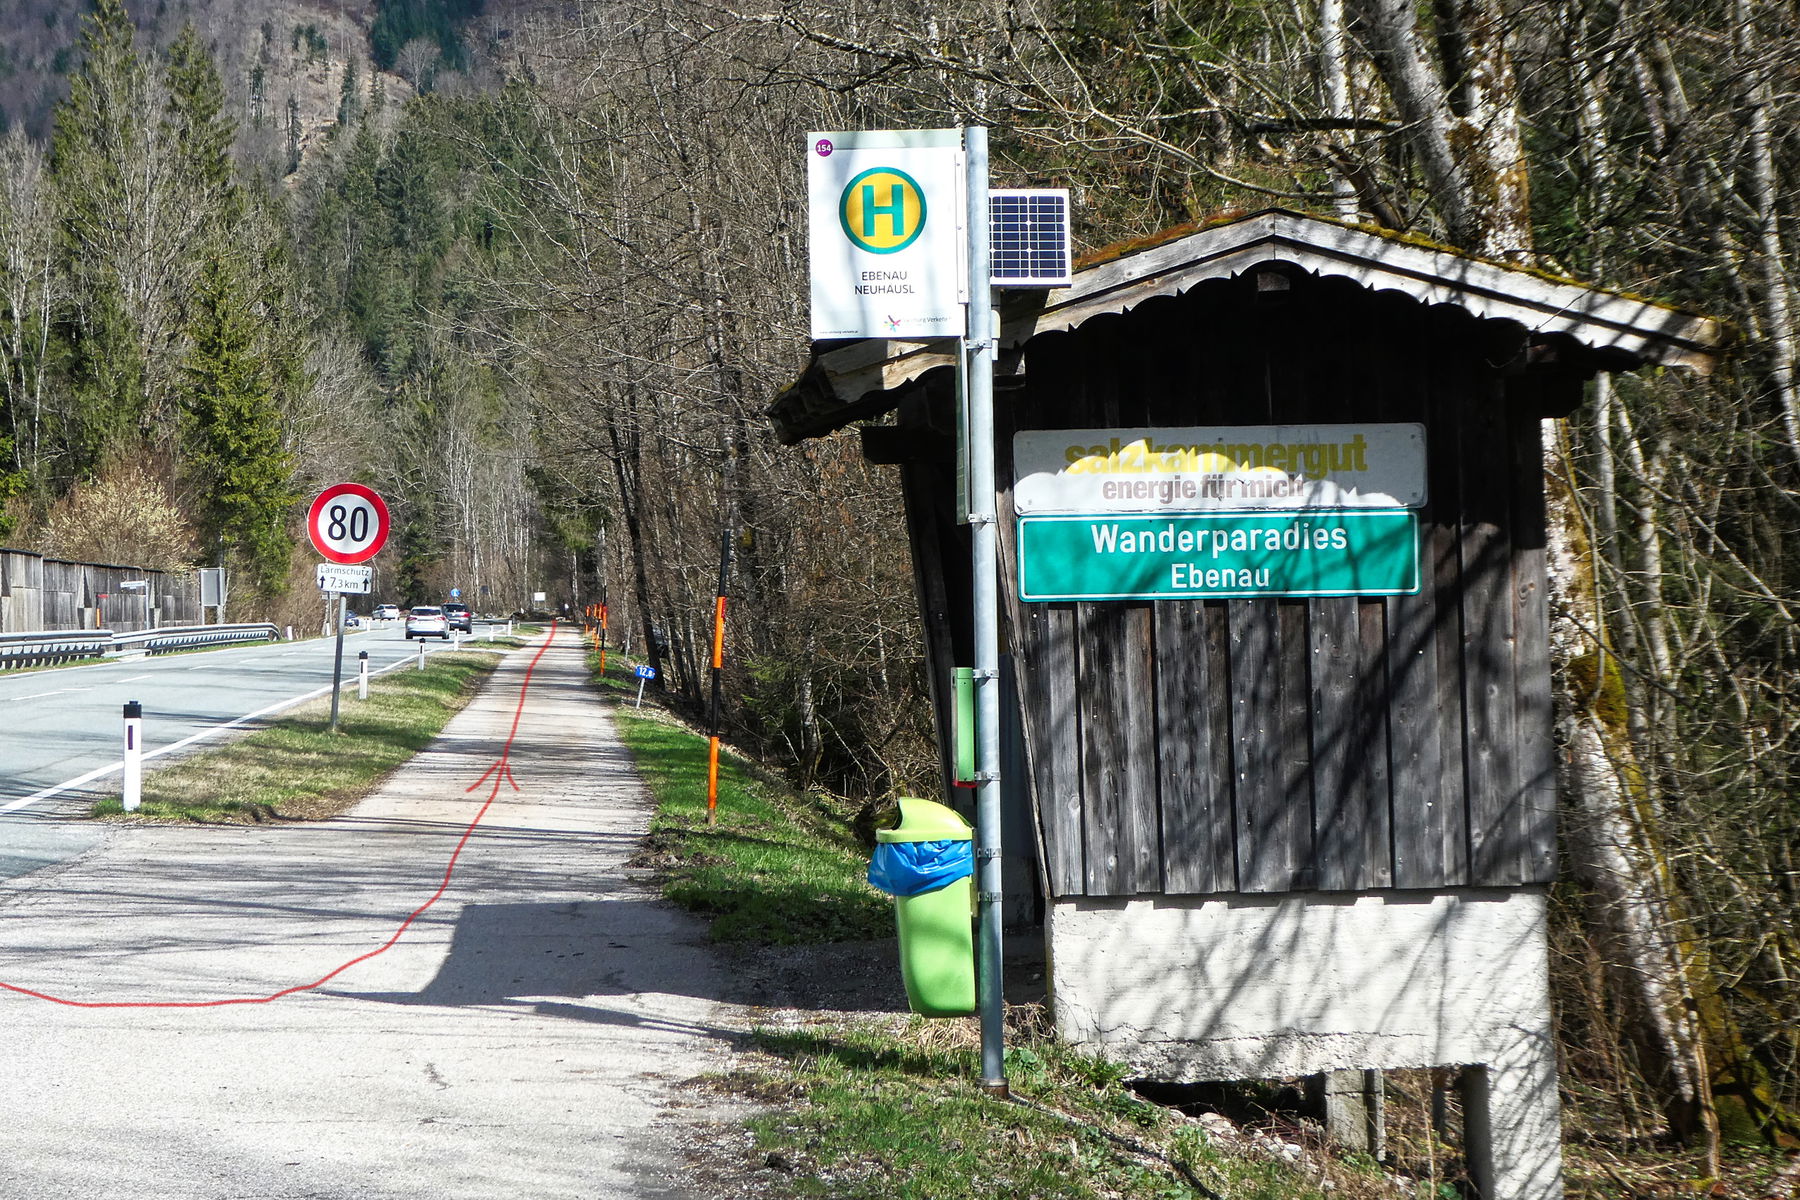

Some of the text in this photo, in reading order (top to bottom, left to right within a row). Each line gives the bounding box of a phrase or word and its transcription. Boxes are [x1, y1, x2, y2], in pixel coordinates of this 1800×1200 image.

[817, 144, 832, 153] 154
[862, 184, 905, 237] H
[862, 271, 908, 281] EBENAU
[1065, 433, 1368, 480] salzkammergut
[1102, 473, 1304, 505] energie für mich
[328, 505, 369, 542] 80
[1091, 522, 1348, 559] Wanderparadies
[344, 580, 359, 590] km
[1170, 564, 1270, 589] Ebenau
